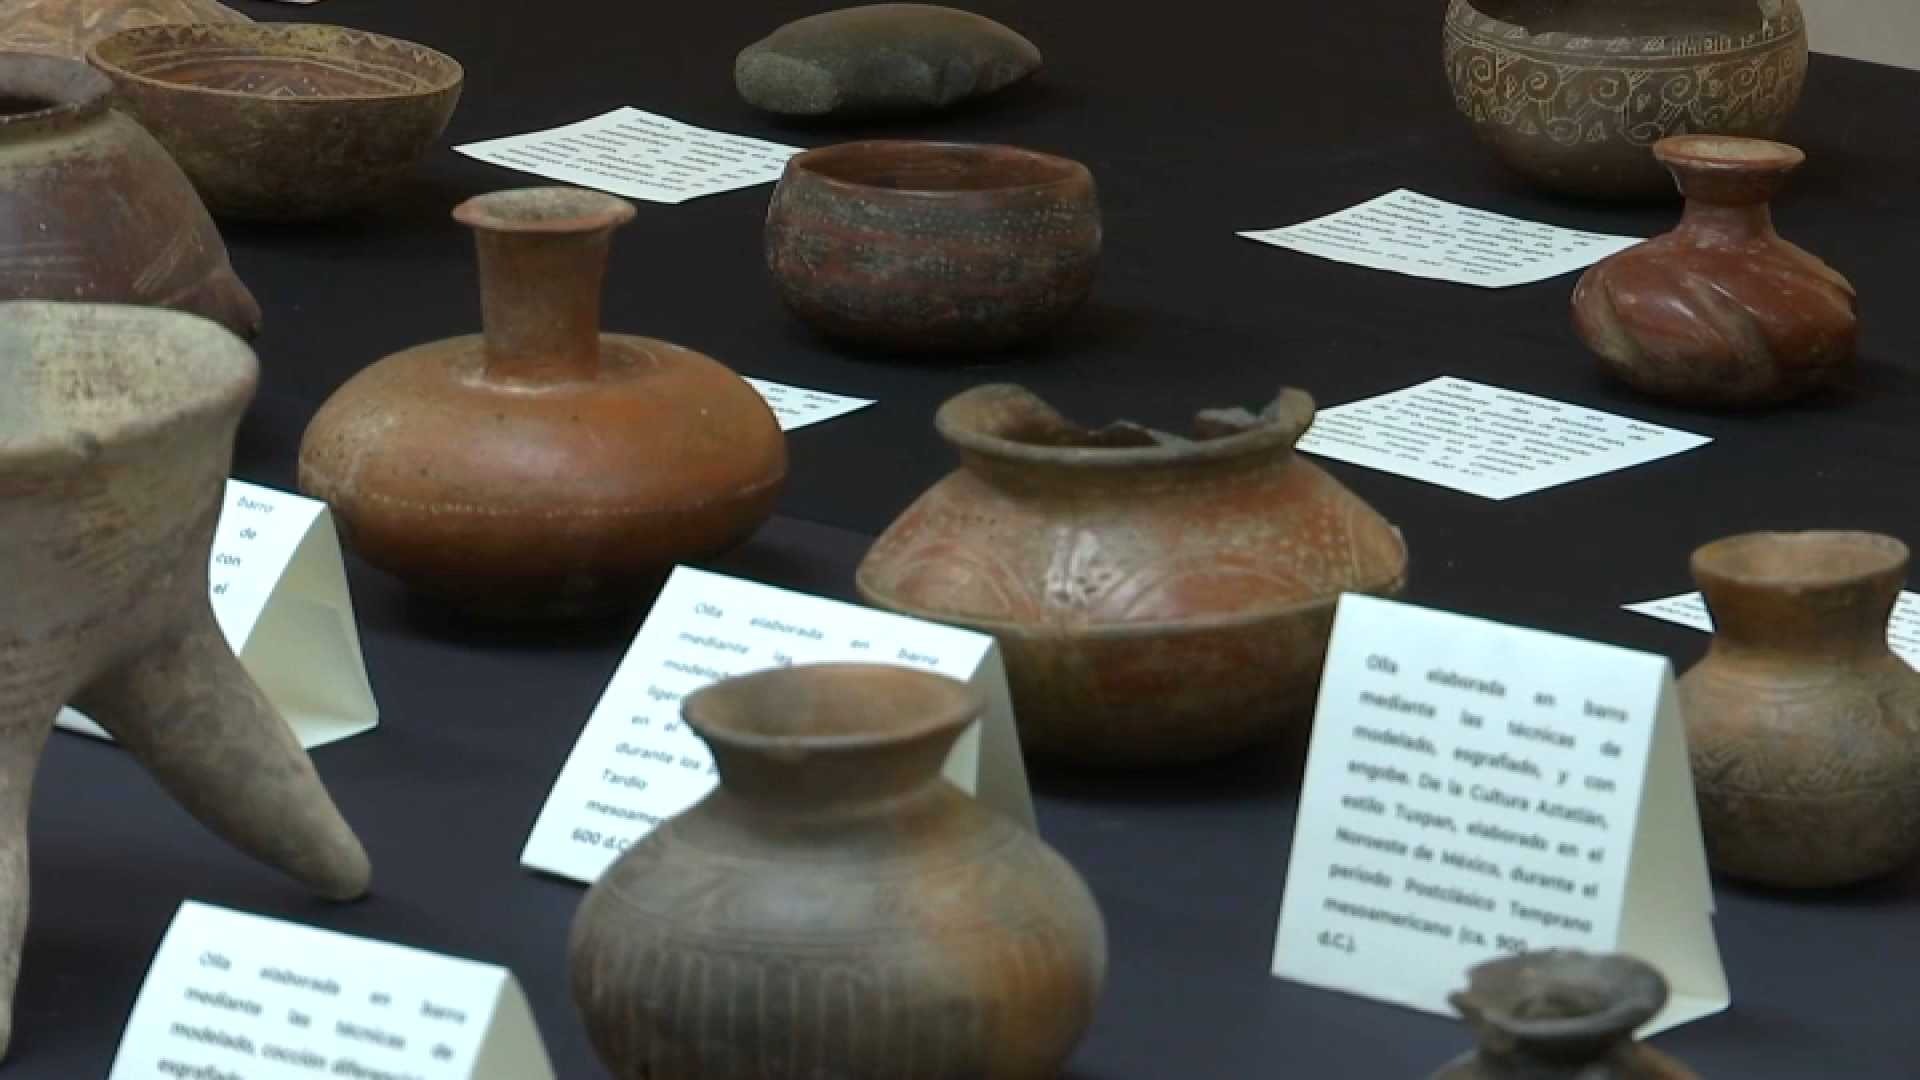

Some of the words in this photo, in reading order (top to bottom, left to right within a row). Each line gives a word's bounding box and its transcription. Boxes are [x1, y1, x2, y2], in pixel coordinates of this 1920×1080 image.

[678, 631, 750, 655] mediante
[692, 601, 725, 620] Olla
[748, 617, 825, 641] elaborada
[849, 638, 871, 652] en
[897, 647, 940, 666] barro
[1366, 653, 1400, 677] Olla
[1426, 668, 1507, 698] elaborada
[1533, 691, 1556, 709] en
[1583, 700, 1629, 724] barro
[630, 714, 652, 727] en
[1359, 690, 1437, 720] mediante
[1459, 710, 1484, 729] las
[1599, 740, 1623, 758] de
[615, 741, 676, 765] durante
[678, 755, 702, 771] los
[1353, 725, 1438, 756] modelado,
[1452, 747, 1542, 780] esgrafiado,
[1556, 770, 1570, 786] y
[1583, 776, 1616, 792] con
[1417, 772, 1442, 791] De
[1446, 779, 1463, 797] la
[1470, 784, 1530, 812] Cultura
[570, 827, 603, 847] 600
[1340, 794, 1386, 816] estilo
[1465, 821, 1549, 851] elaborado
[1556, 842, 1580, 858] en
[1585, 848, 1606, 864] el
[1335, 826, 1409, 856] Noroeste
[1412, 843, 1435, 861] de
[1509, 865, 1576, 894] durante
[1582, 883, 1599, 899] el
[1322, 897, 1453, 938] mesoamericano
[1509, 900, 1593, 934] Temprano
[183, 986, 264, 1018] mediante
[199, 951, 232, 972] Olla
[259, 967, 341, 997] elaborada
[368, 990, 392, 1007] en
[419, 1000, 467, 1025] barro
